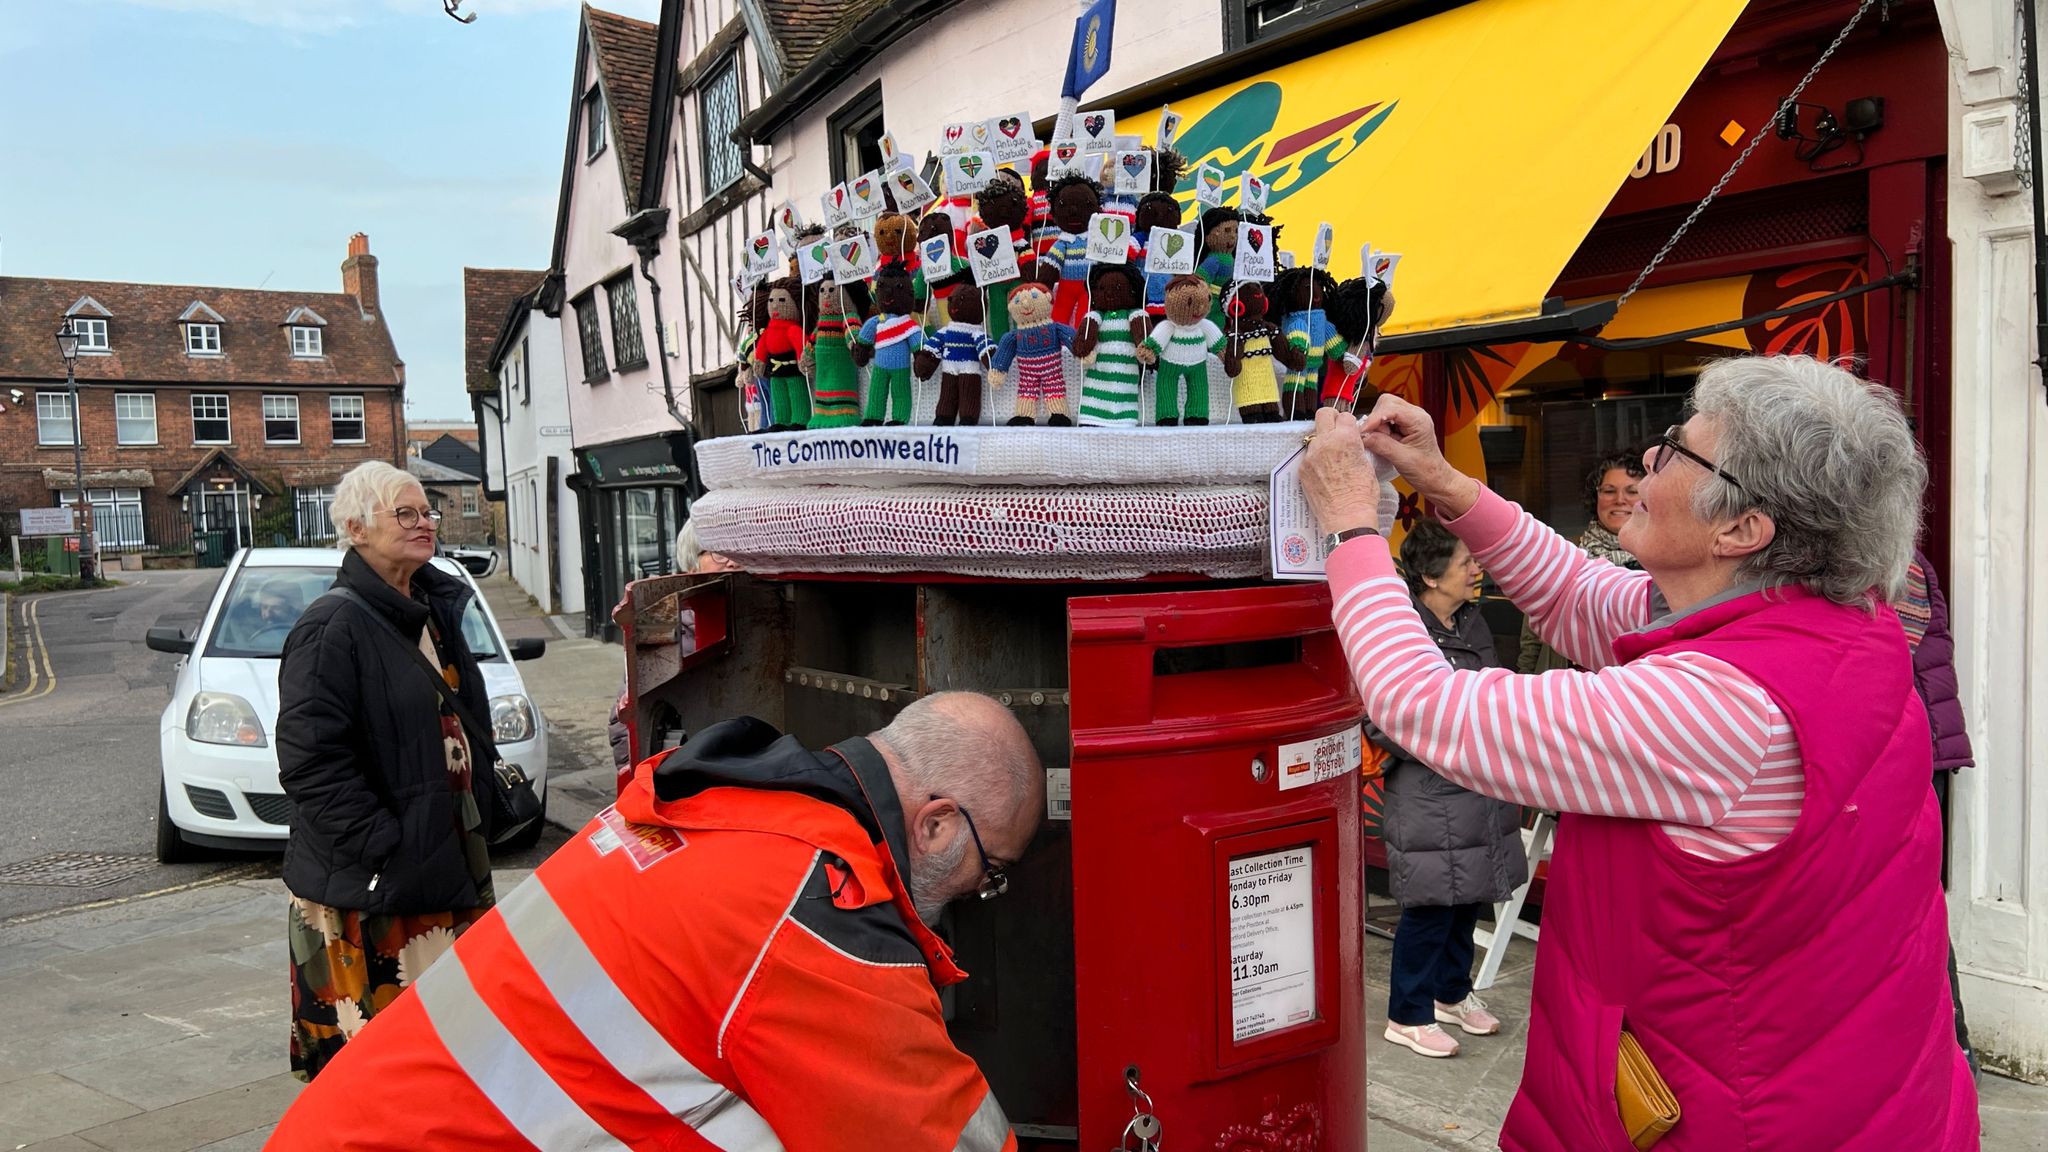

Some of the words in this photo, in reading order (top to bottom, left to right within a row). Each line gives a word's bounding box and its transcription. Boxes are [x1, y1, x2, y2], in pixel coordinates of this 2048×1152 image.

[996, 138, 1025, 150] Antigua
[998, 149, 1028, 161] Barbuda
[1093, 243, 1124, 258] Nigeria
[927, 264, 947, 275] Nauru
[980, 259, 1000, 269] New
[1153, 257, 1190, 271] Pakistan
[840, 266, 870, 279] Namibia
[982, 263, 1015, 281] Zealand
[751, 441, 781, 468] The
[787, 434, 960, 465] Commonwealth
[1230, 867, 1243, 876] ast
[1245, 859, 1283, 873] Collection
[1284, 855, 1304, 866] Time
[1259, 878, 1267, 886] to
[1268, 873, 1293, 884] Friday
[1232, 894, 1270, 910] 6.30pm
[1232, 950, 1263, 965] aturday
[1233, 962, 1279, 981] 11.30am
